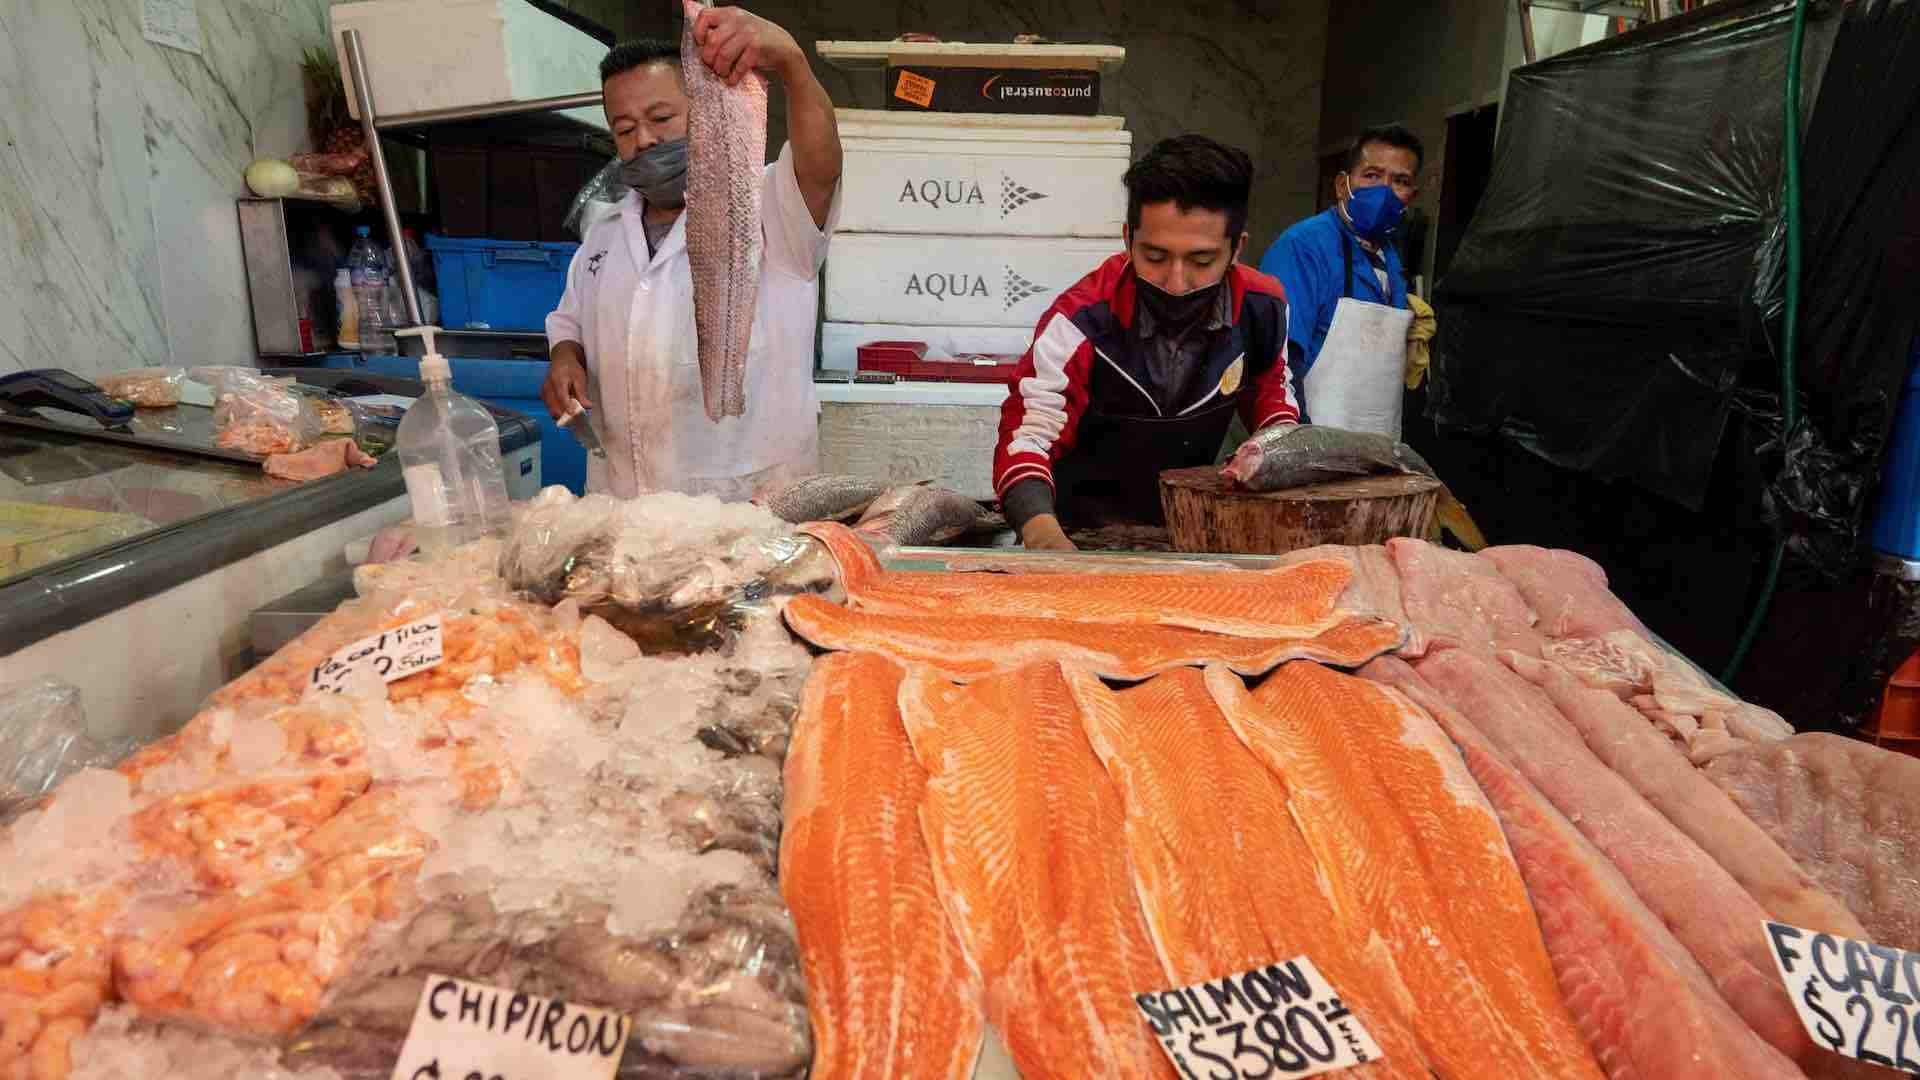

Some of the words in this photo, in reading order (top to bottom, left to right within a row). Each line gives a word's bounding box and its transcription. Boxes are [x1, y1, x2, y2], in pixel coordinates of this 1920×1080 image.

[1000, 83, 1092, 101] puntoaustral
[898, 179, 985, 208] AQUA
[904, 272, 990, 301] AQUA
[1767, 922, 1803, 972] F
[429, 980, 624, 1056] CHIPIRON
[1135, 961, 1313, 1036] SALMON
[1803, 974, 1920, 1074] $22
